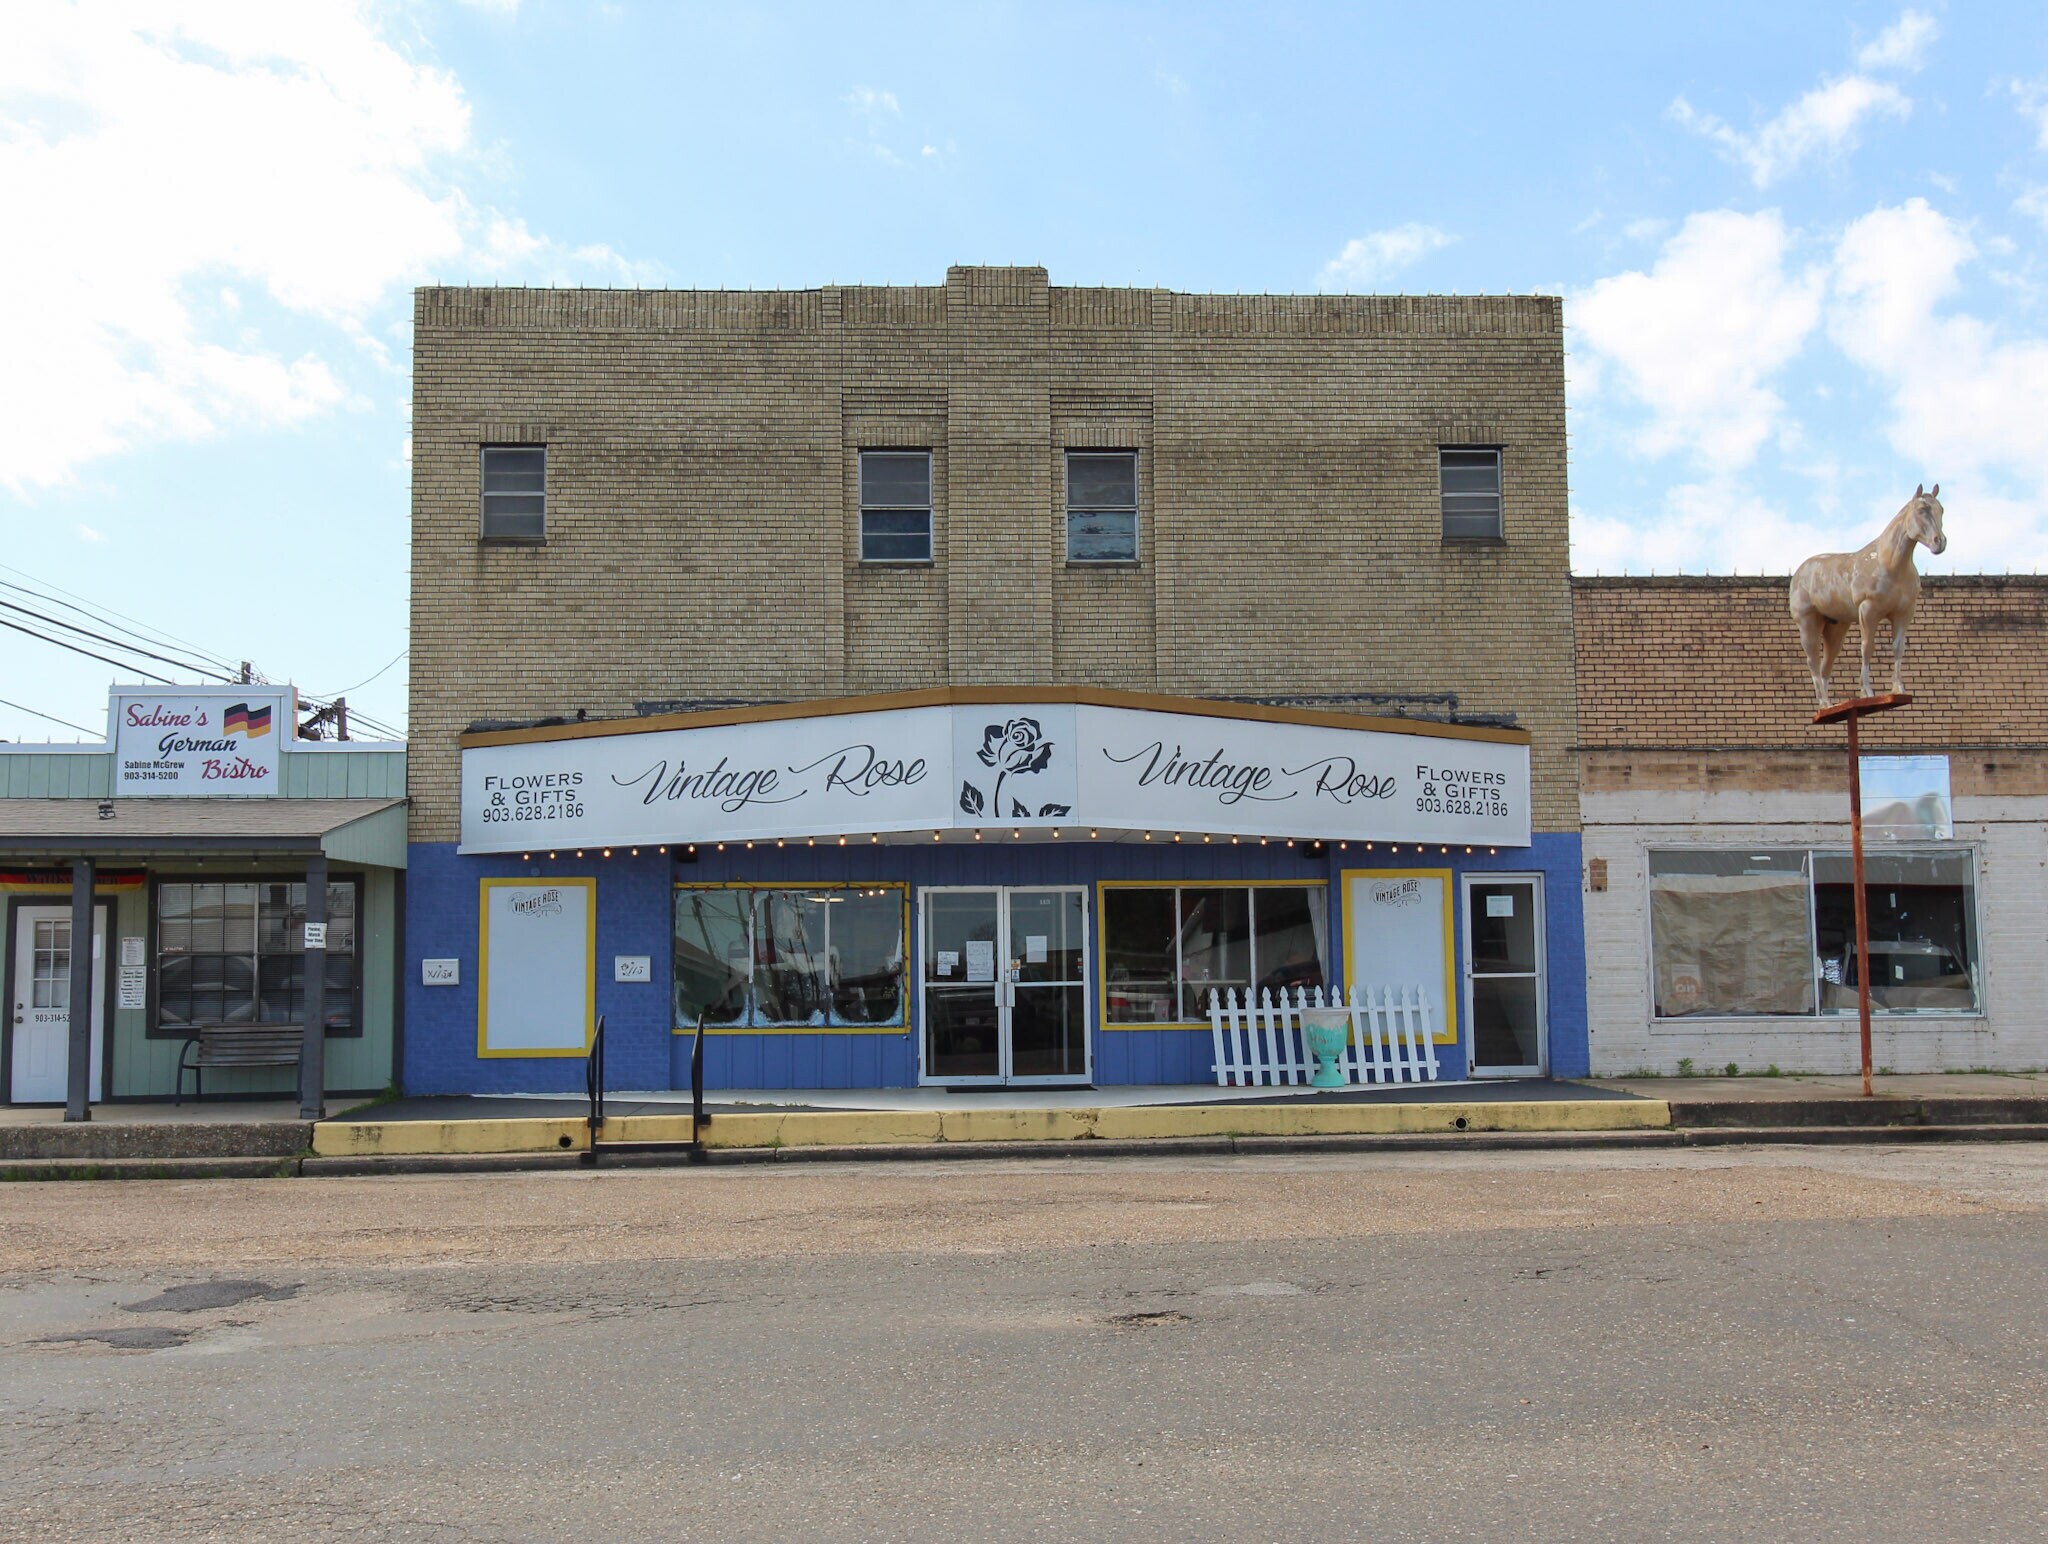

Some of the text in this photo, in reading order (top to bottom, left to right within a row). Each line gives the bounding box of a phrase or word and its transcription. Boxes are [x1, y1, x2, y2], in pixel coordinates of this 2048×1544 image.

[126, 703, 209, 727] Sabine's
[158, 732, 237, 759] German
[124, 760, 185, 769] Sabine McGrew
[202, 756, 270, 780] Bistro
[1102, 741, 1397, 805] Vintage Rose
[124, 771, 179, 780] 903-314-5200
[485, 772, 584, 791] FLOWERS
[611, 744, 928, 813] Vintage Rose
[1416, 765, 1506, 786] FLOWERS
[491, 789, 577, 805] & GIFTS
[1423, 783, 1501, 801] & GIFTS
[483, 805, 584, 823] 903.628.2186
[1416, 798, 1508, 817] 903.628.2186
[514, 891, 559, 912] VINTAGE ROSE
[1375, 882, 1418, 902] VINTAGE ROSE
